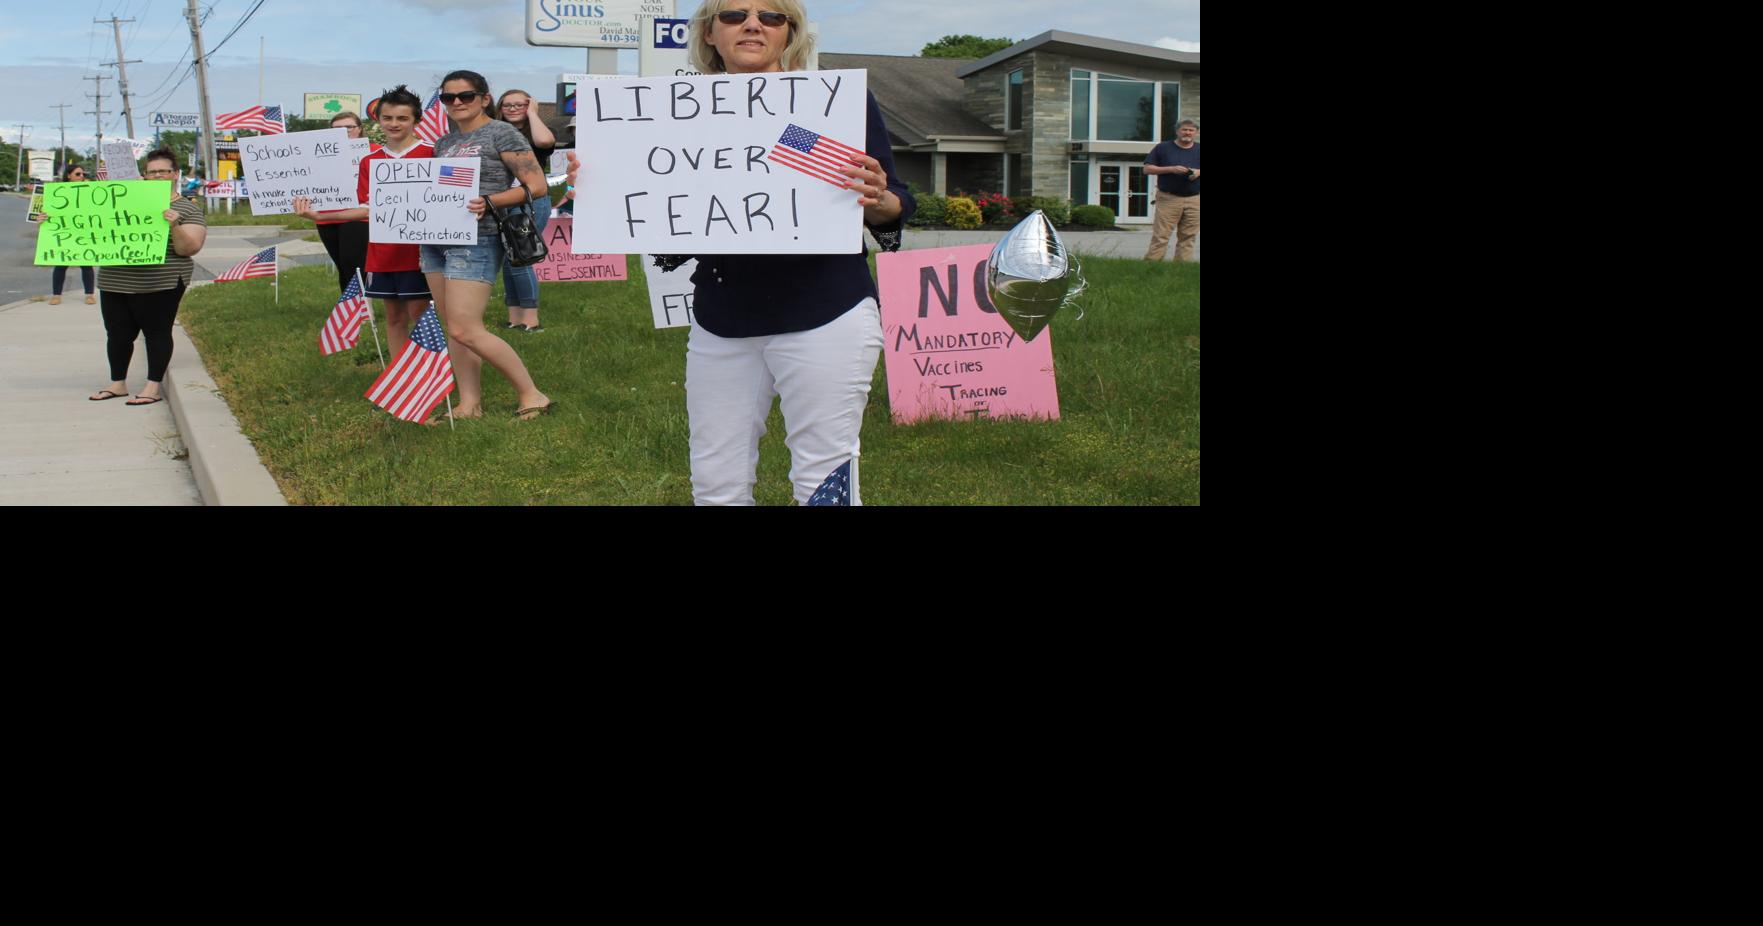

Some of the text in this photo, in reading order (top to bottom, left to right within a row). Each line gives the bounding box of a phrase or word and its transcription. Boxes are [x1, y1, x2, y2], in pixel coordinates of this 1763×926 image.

[641, 5, 666, 13] NOSE
[600, 26, 623, 35] David
[594, 75, 842, 122] LIBERTY
[154, 113, 199, 125] A Storage
[167, 119, 197, 127] Depot
[247, 144, 301, 162] Schools
[314, 143, 341, 156] ARE
[648, 145, 770, 174] OVER
[255, 166, 312, 182] Essential
[376, 160, 432, 182] OPEN
[51, 183, 128, 210] STOP
[311, 185, 340, 196] county
[375, 186, 465, 208] Cecil County
[110, 210, 153, 226] the
[406, 208, 427, 222] NO
[625, 188, 799, 240] FEAR!
[53, 230, 162, 247] Petitions
[391, 223, 472, 241] Restrictions
[557, 264, 622, 281] ESSENTIAL
[939, 384, 1008, 401] TRACING
